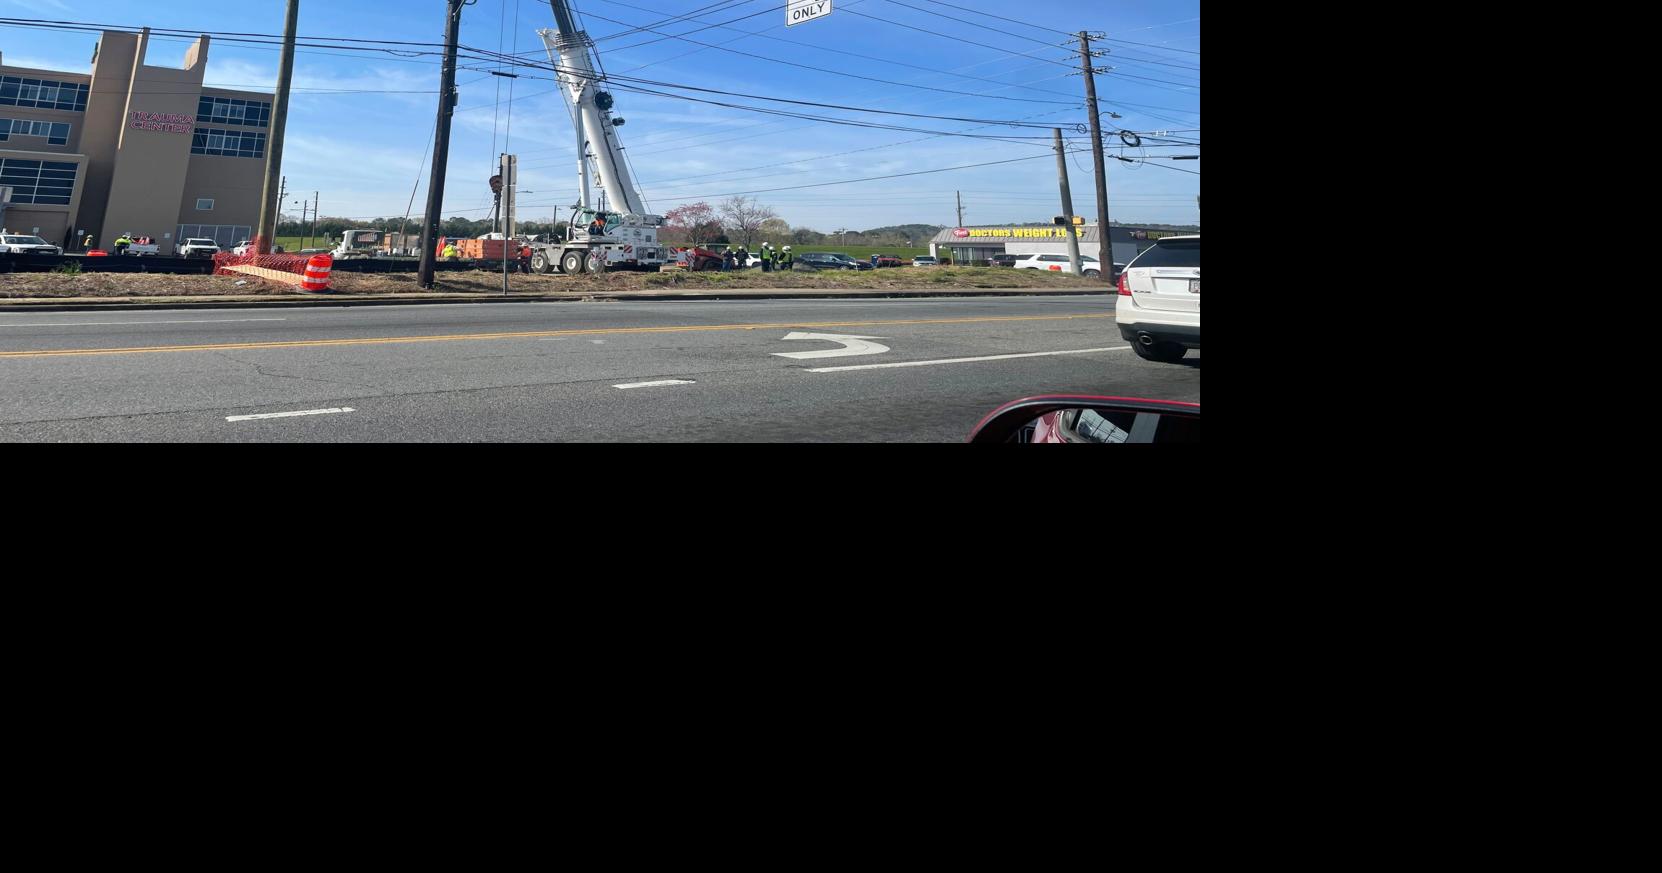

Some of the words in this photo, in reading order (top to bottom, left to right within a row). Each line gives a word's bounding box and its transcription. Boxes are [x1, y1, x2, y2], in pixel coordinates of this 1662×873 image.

[793, 2, 825, 20] ONLY
[130, 111, 195, 124] TRAUMA
[130, 120, 191, 134] CENTER
[970, 229, 1011, 237] DOCTORS
[1012, 228, 1053, 238] WEIGHT
[1055, 228, 1083, 237] LOS
